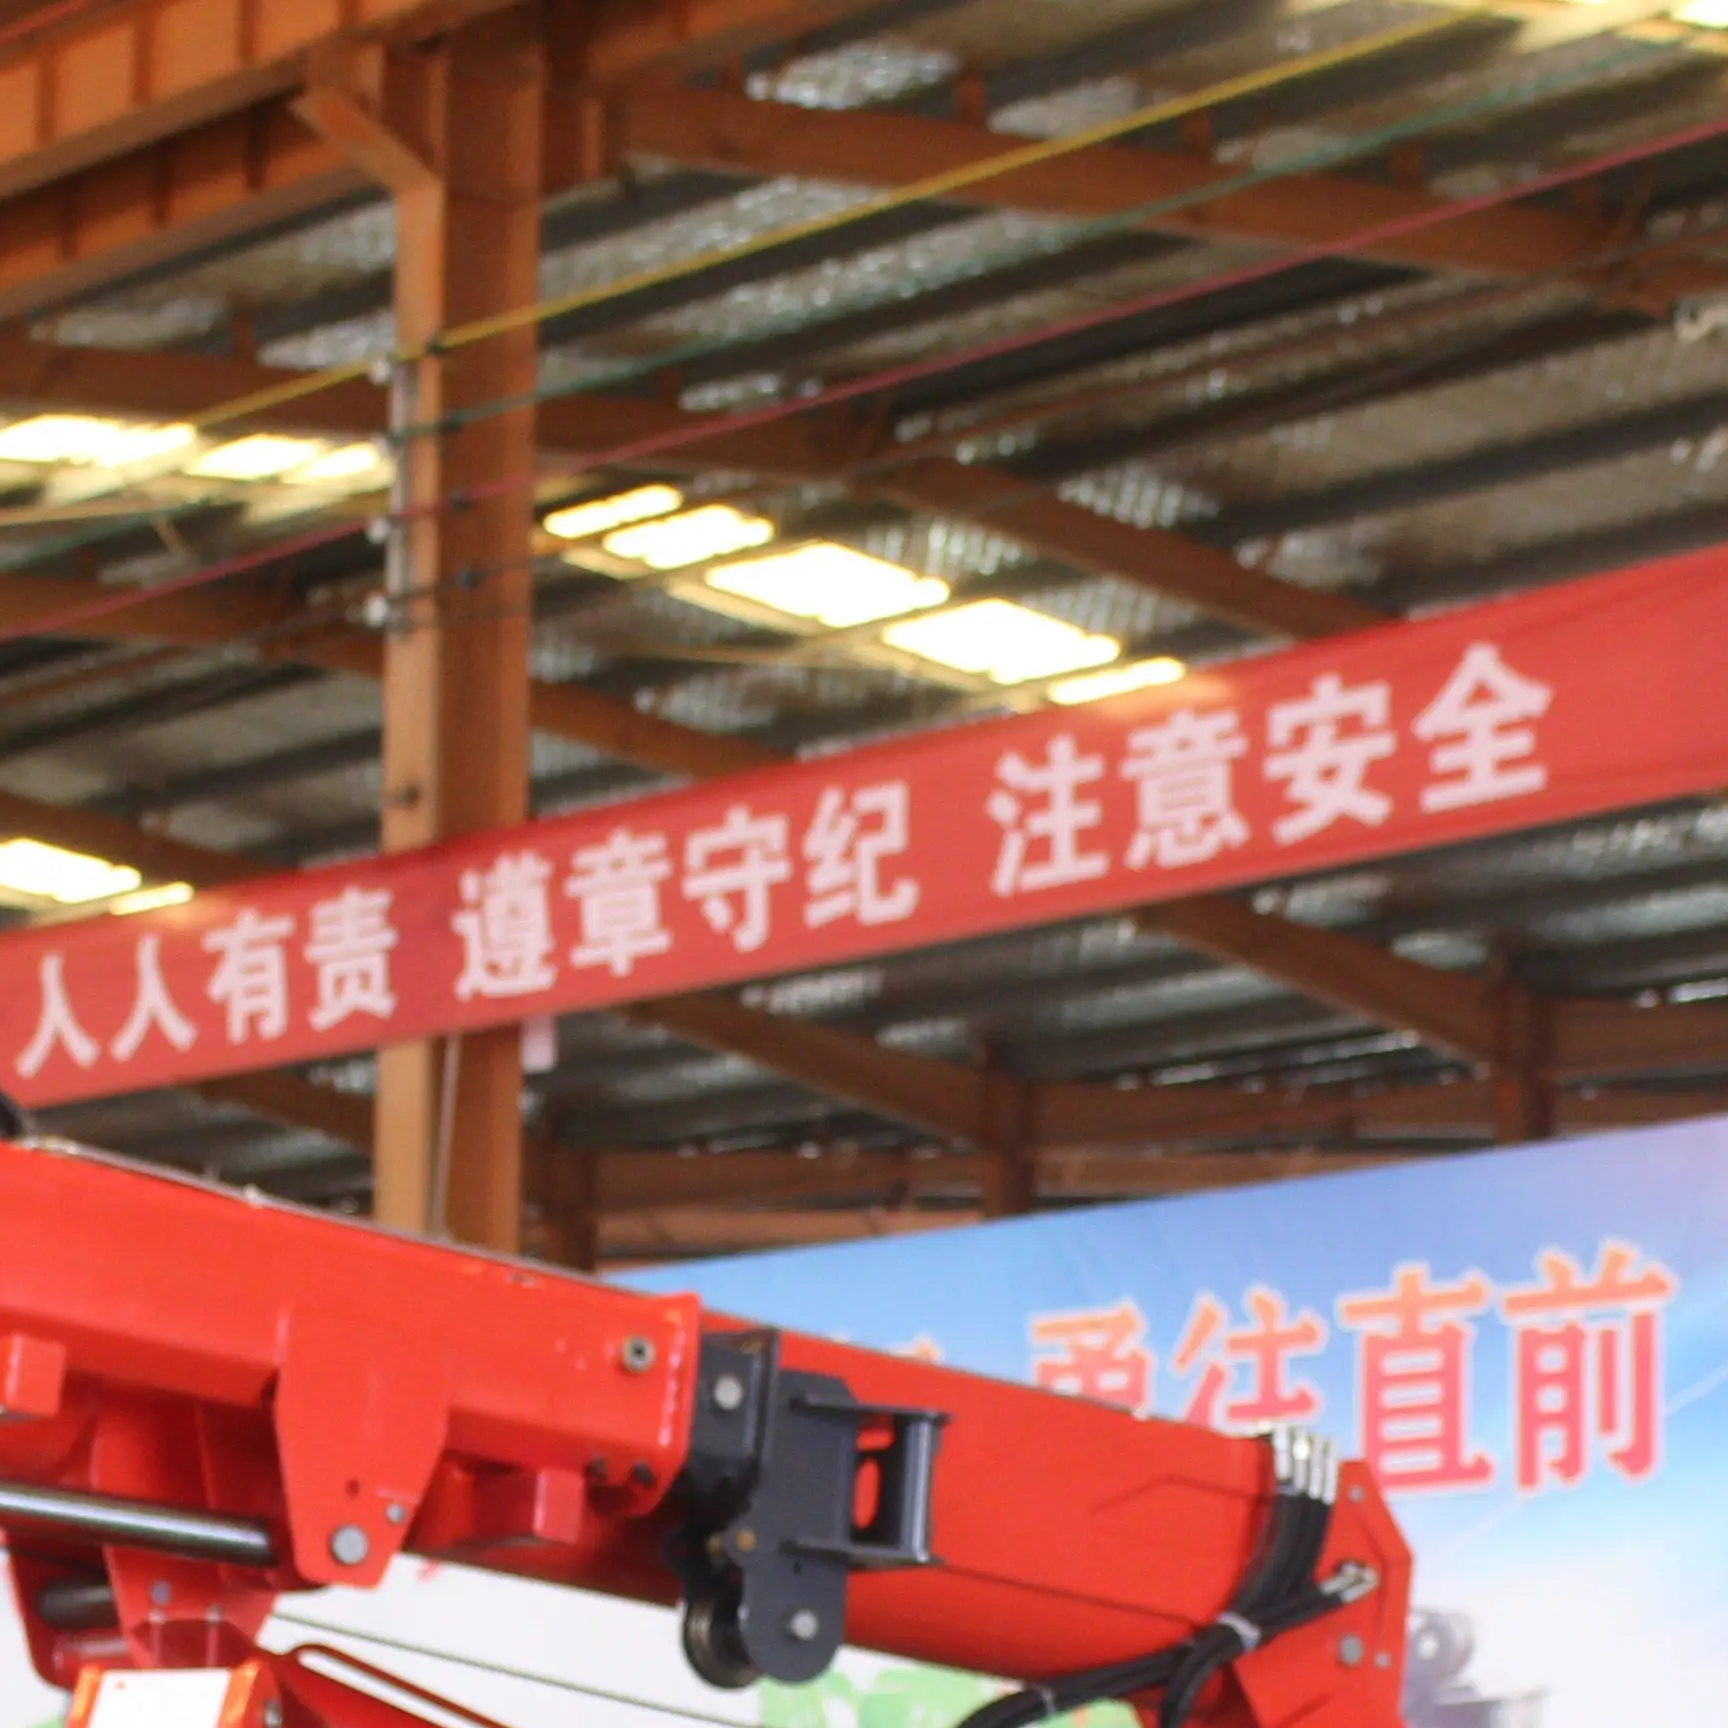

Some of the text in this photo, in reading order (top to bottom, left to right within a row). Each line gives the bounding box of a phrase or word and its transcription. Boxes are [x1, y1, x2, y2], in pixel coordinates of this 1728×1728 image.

[16, 884, 400, 1078] 人人有责
[453, 780, 918, 1000] 遵章守纪
[985, 642, 1555, 899] 注意安全
